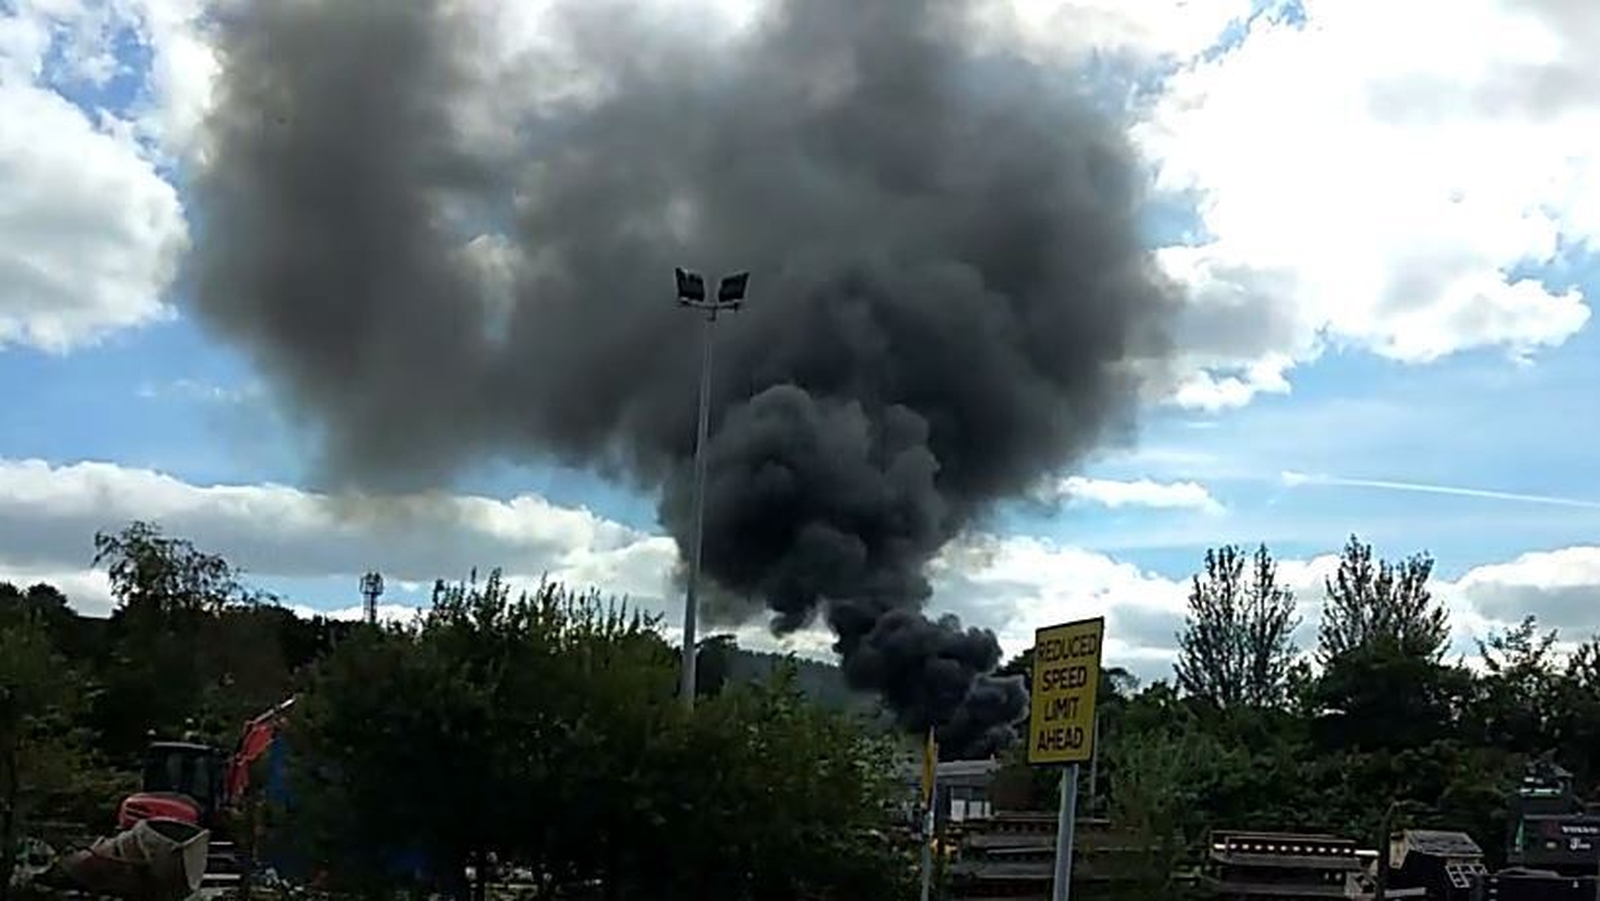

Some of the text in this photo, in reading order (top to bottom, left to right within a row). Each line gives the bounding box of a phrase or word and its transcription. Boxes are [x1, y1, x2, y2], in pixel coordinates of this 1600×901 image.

[1038, 634, 1097, 662] REDUCED
[1042, 666, 1087, 692] SPEED
[1044, 697, 1079, 722] LIMIT
[1037, 727, 1083, 751] AHEAD
